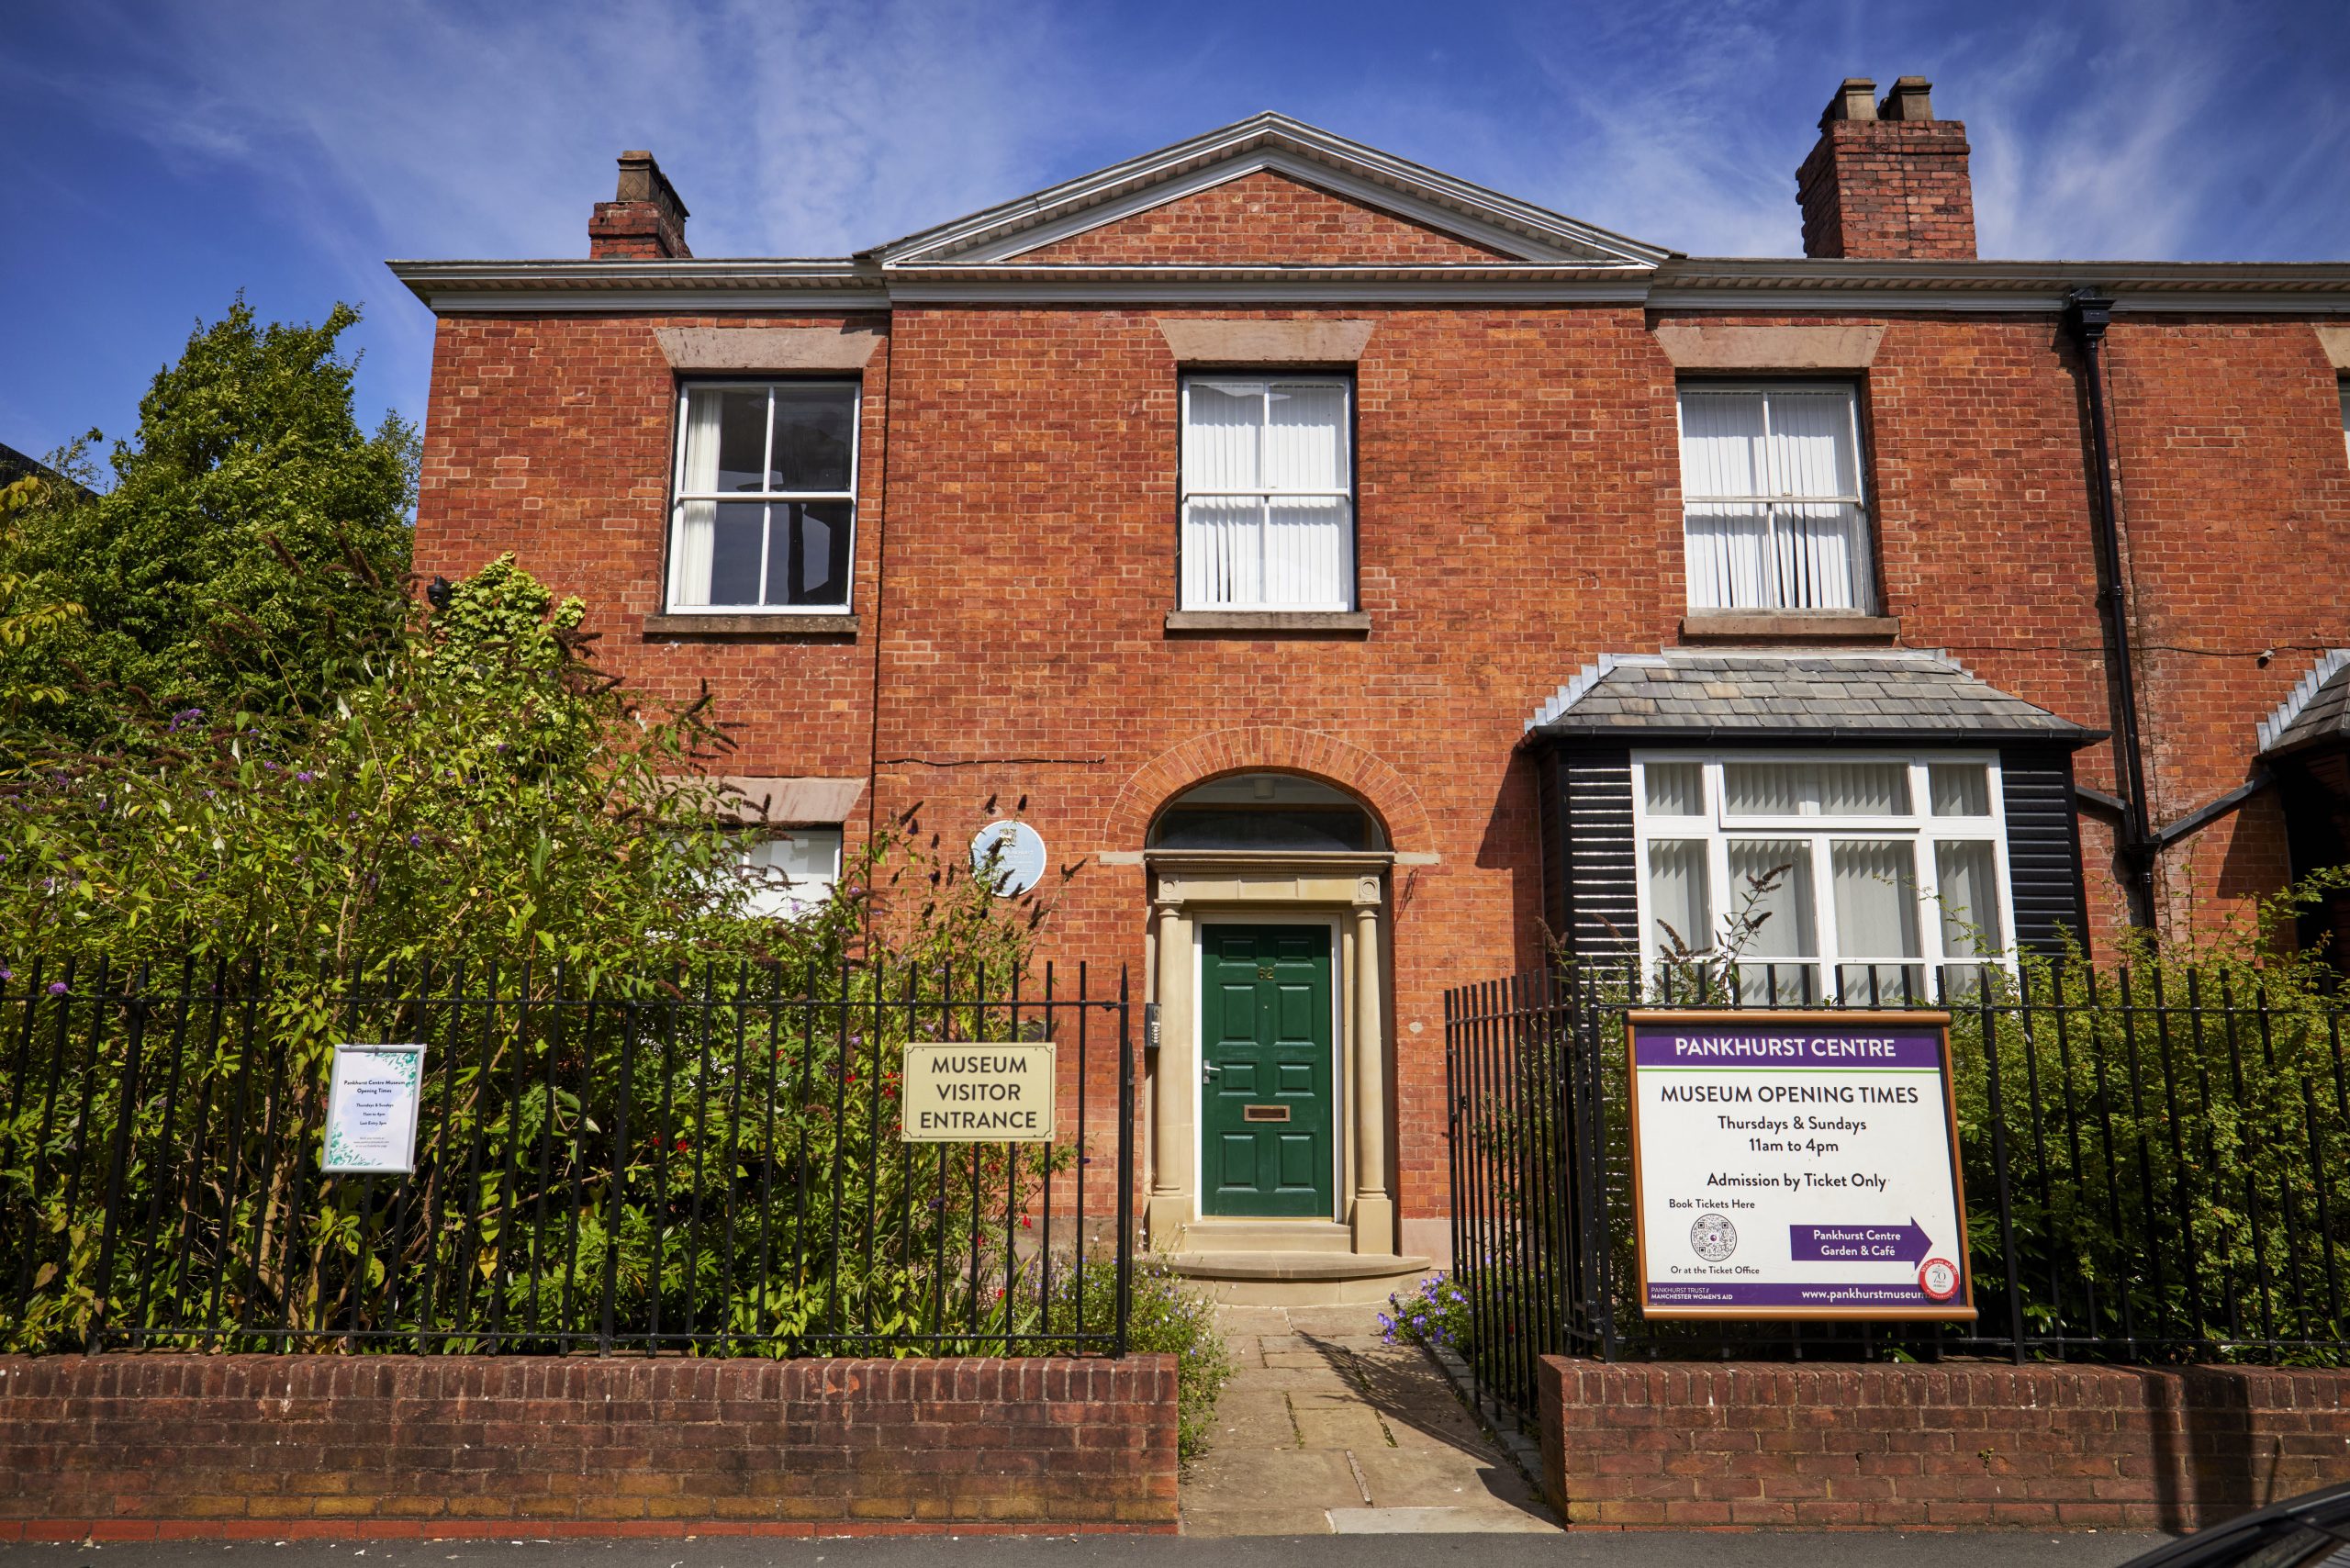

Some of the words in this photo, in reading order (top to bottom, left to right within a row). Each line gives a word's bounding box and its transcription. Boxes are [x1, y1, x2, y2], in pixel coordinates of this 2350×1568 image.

[1258, 967, 1274, 980] 62
[1675, 1038, 1805, 1056] PANKHURST
[1811, 1039, 1896, 1057] CENTRE
[932, 1057, 1026, 1073] MUSEUM
[936, 1084, 1021, 1101] VISITOR
[1662, 1086, 1752, 1102] MUSEUM
[1758, 1086, 1853, 1103] OPENING
[1859, 1087, 1918, 1103] TIMES
[921, 1112, 1036, 1128] ENTRANCE
[1718, 1116, 1788, 1135] Thursdays
[1794, 1116, 1804, 1129] &
[1808, 1116, 1866, 1135] Sundays
[1750, 1138, 1783, 1151] 11am
[1787, 1141, 1801, 1151] to
[1806, 1138, 1838, 1157] 4pm
[1707, 1172, 1779, 1186] Admission
[1784, 1173, 1800, 1192] by
[1804, 1173, 1847, 1186] Ticket
[1852, 1173, 1886, 1192] Only
[1670, 1199, 1693, 1208] Book
[1695, 1199, 1729, 1208] Tickets
[1732, 1199, 1755, 1208] Here
[1814, 1230, 1863, 1239] Pankhurst
[1866, 1230, 1900, 1240] Centre
[1821, 1245, 1857, 1255] Garden
[1861, 1246, 1869, 1255] &
[1872, 1246, 1895, 1256] Café
